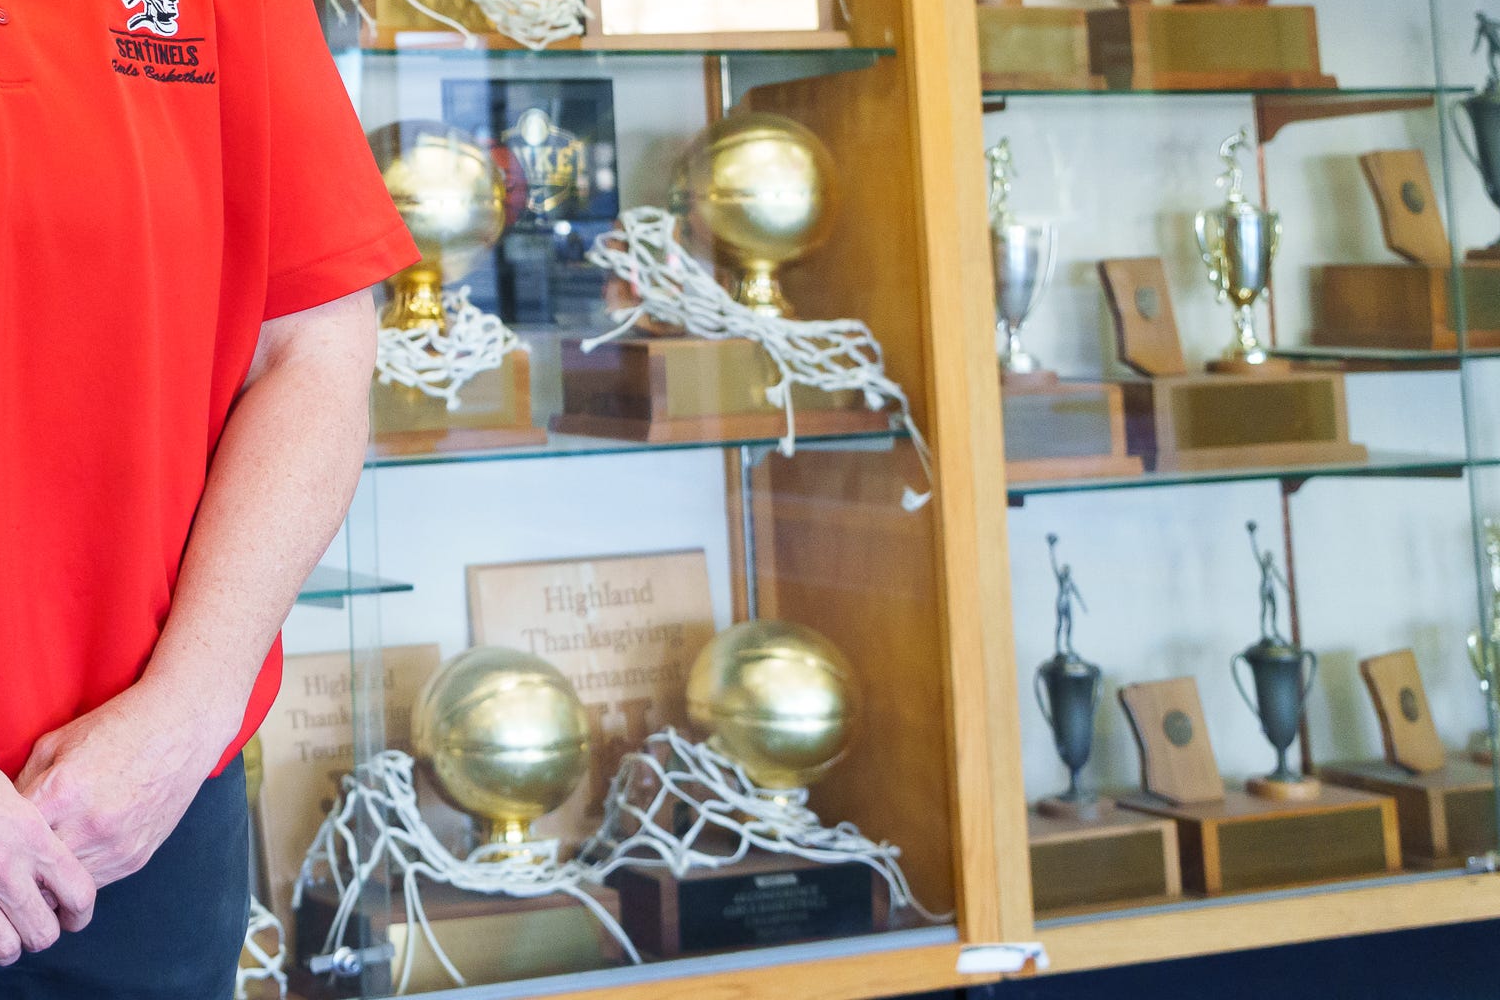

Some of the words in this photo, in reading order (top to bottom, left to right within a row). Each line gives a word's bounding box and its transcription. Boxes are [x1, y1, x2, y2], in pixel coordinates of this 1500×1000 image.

[114, 37, 200, 67] SENTINELS
[143, 65, 216, 85] Basketball
[542, 578, 655, 617] Highland
[520, 619, 684, 656] Thanksgiving
[568, 662, 682, 691] urnament
